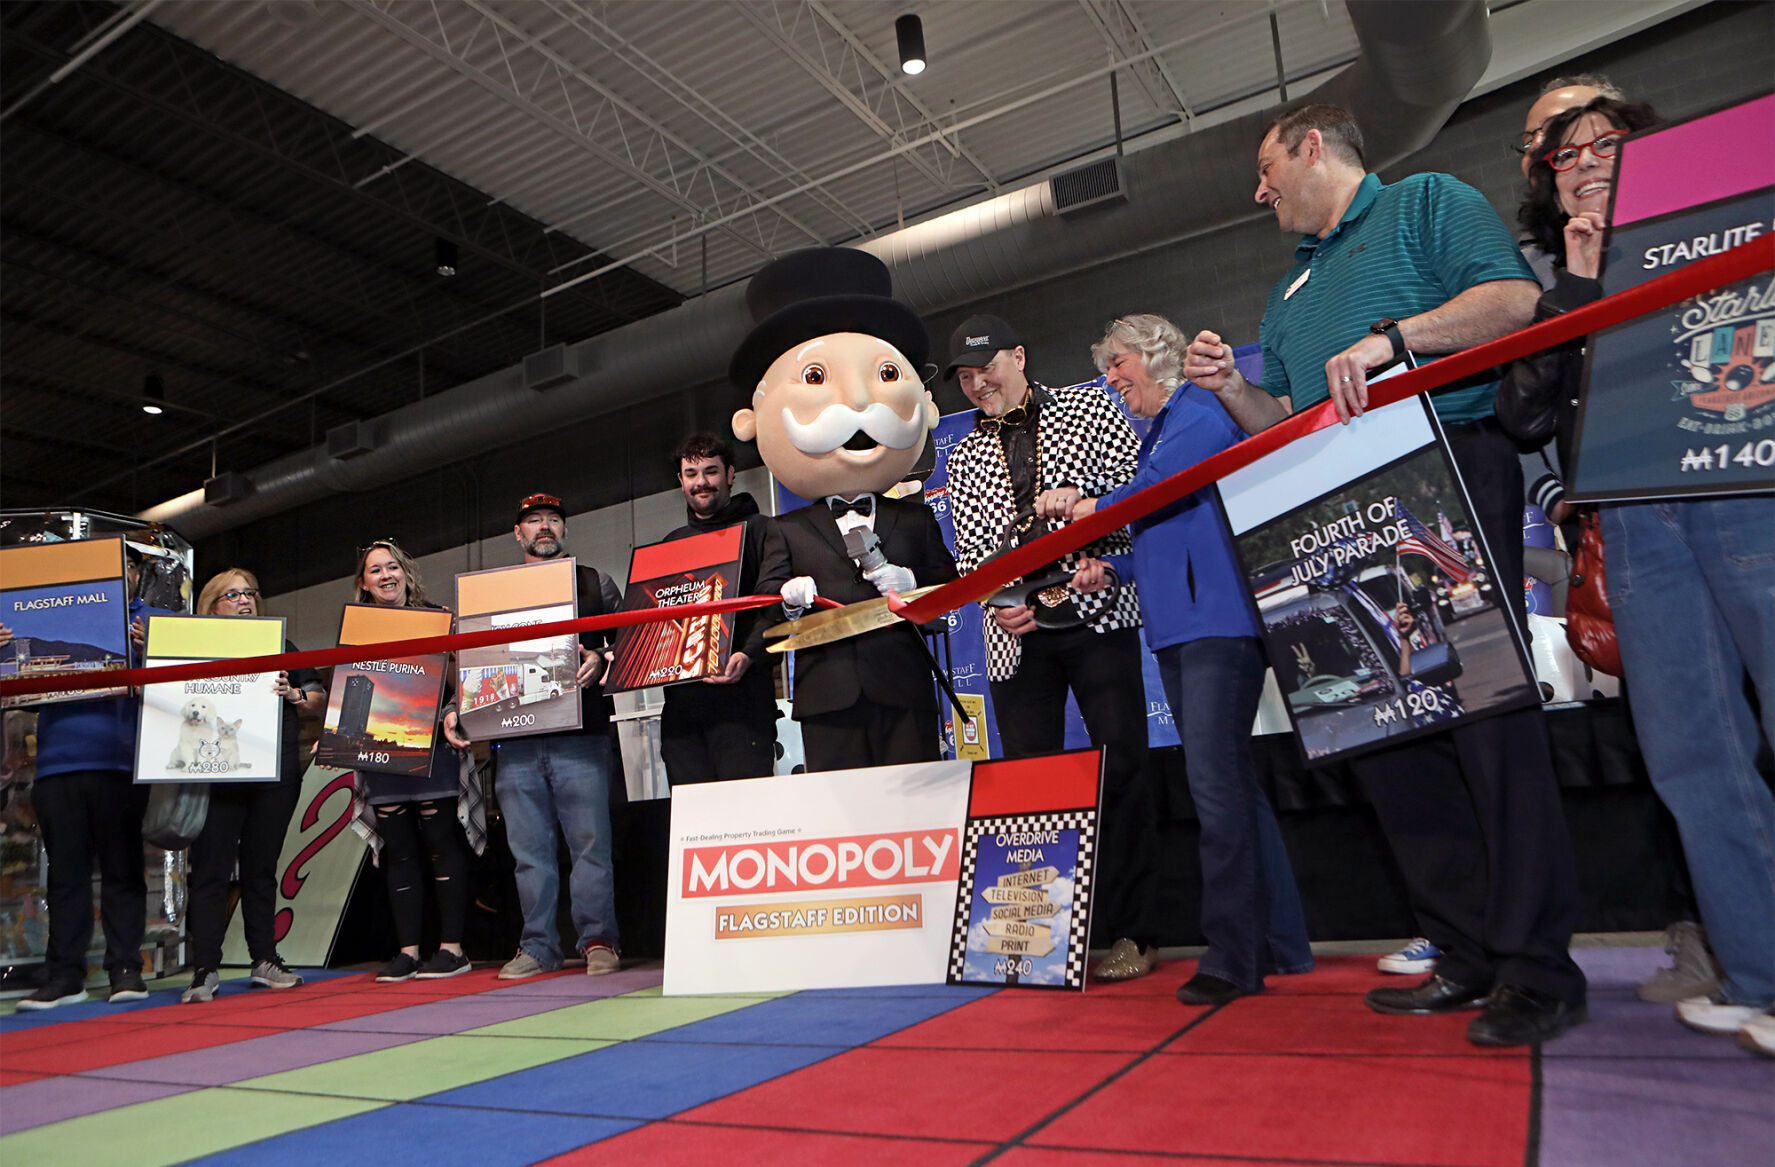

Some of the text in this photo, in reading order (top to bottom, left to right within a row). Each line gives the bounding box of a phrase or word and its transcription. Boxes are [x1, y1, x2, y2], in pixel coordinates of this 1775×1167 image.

[1642, 222, 1764, 270] STARLITE
[1290, 496, 1397, 558] FOURTH OF
[1290, 518, 1413, 586] JULY PARADE
[655, 580, 705, 599] ORPHEUM
[14, 592, 109, 612] FLAGSTAFF MALL
[657, 591, 700, 609] THEATER
[389, 662, 426, 676] PURINA
[184, 682, 242, 695] HUMANE
[724, 831, 752, 840] Property
[753, 829, 776, 838] Trading
[996, 830, 1059, 847] OVERDRIVE
[688, 833, 954, 892] MONOPOLY
[1006, 849, 1045, 863] MEDIA
[1003, 869, 1050, 888] INTERNET
[991, 888, 1044, 902] TELEVISION
[718, 903, 918, 933] FLAGSTAFF EDITION
[993, 903, 1054, 920] SOCIAL MEDIA
[1005, 923, 1035, 936] RADIO
[1001, 940, 1030, 952] PRINT
